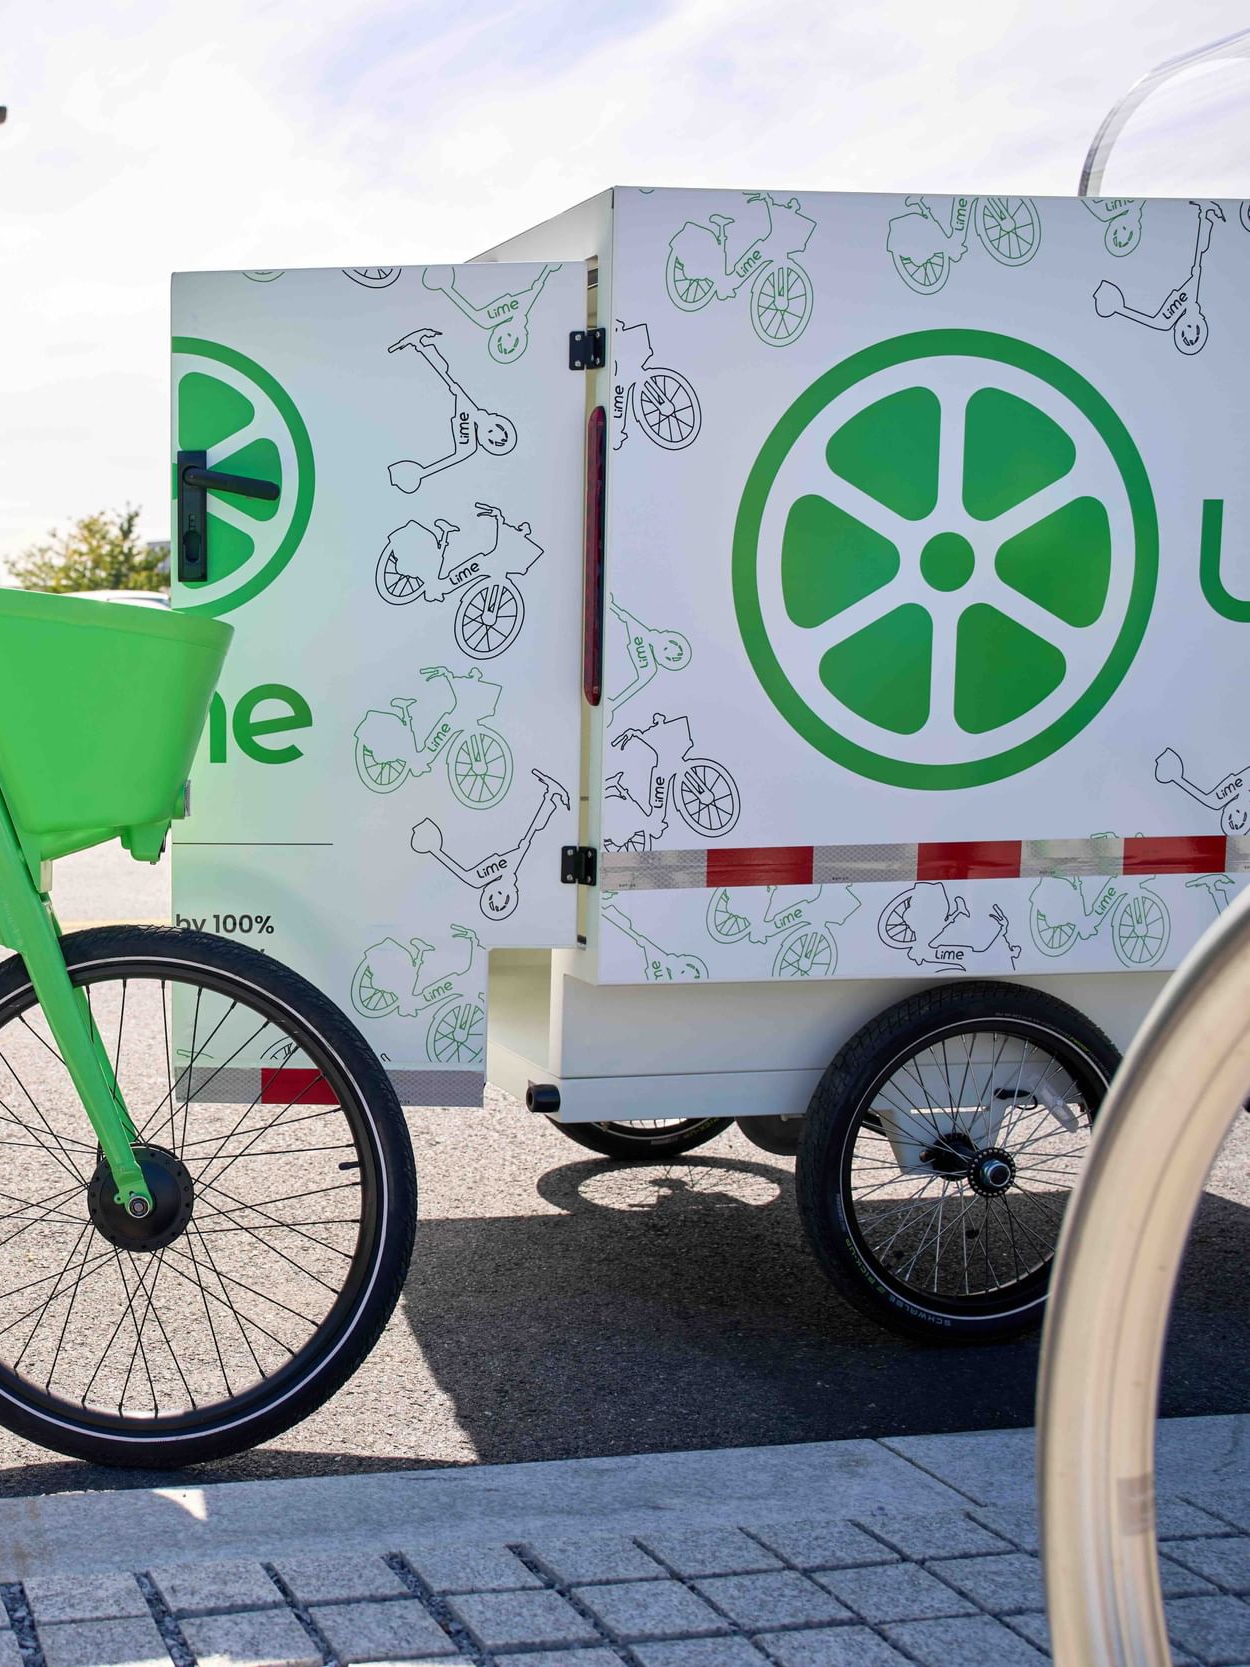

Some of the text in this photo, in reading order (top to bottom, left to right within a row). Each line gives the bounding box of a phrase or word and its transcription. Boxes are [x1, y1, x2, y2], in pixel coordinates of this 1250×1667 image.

[954, 198, 968, 231] Lime
[737, 251, 761, 278] Lime
[487, 299, 519, 319] Lime
[1163, 293, 1188, 319] Lime
[613, 384, 625, 419] Lime
[458, 411, 471, 445] Lime
[450, 562, 479, 585] Lime
[633, 636, 647, 669] Lime
[428, 723, 451, 753] Lime
[653, 776, 665, 809] Lime
[1216, 777, 1243, 800] Lime
[477, 857, 508, 879] Lime
[1095, 888, 1116, 915] Lime
[213, 914, 275, 934] 100%
[774, 909, 802, 928] Lime
[935, 948, 964, 960] Lime
[424, 981, 453, 1001] Lime
